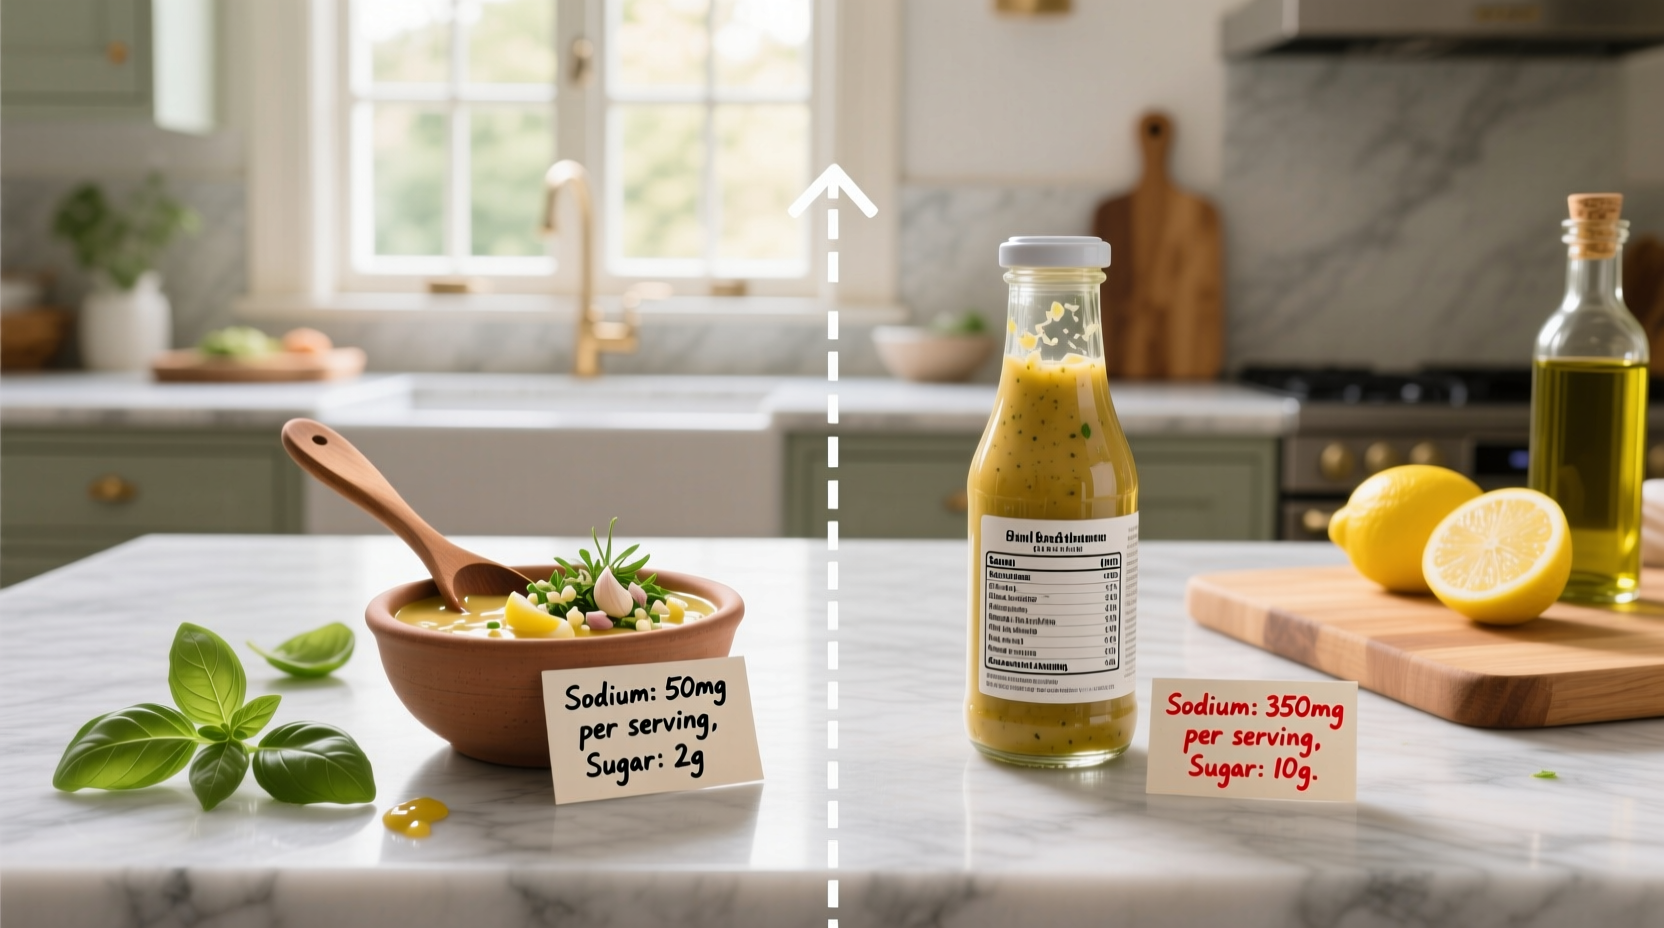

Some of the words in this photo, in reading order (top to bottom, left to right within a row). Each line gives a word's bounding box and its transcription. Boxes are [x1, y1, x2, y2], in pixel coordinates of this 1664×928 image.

[564, 680, 657, 711] Sodium:
[665, 675, 727, 707] 50mg
[1165, 691, 1258, 717] Sodium:
[1265, 693, 1345, 731] 350mg
[579, 722, 619, 752] per
[627, 710, 718, 741] serving,
[1182, 728, 1224, 755] per
[1231, 726, 1322, 759] serving,
[586, 751, 664, 787] Sugar:
[674, 742, 705, 779] 2g
[1187, 752, 1264, 790] Sugar:
[1273, 756, 1319, 793] 10g.
